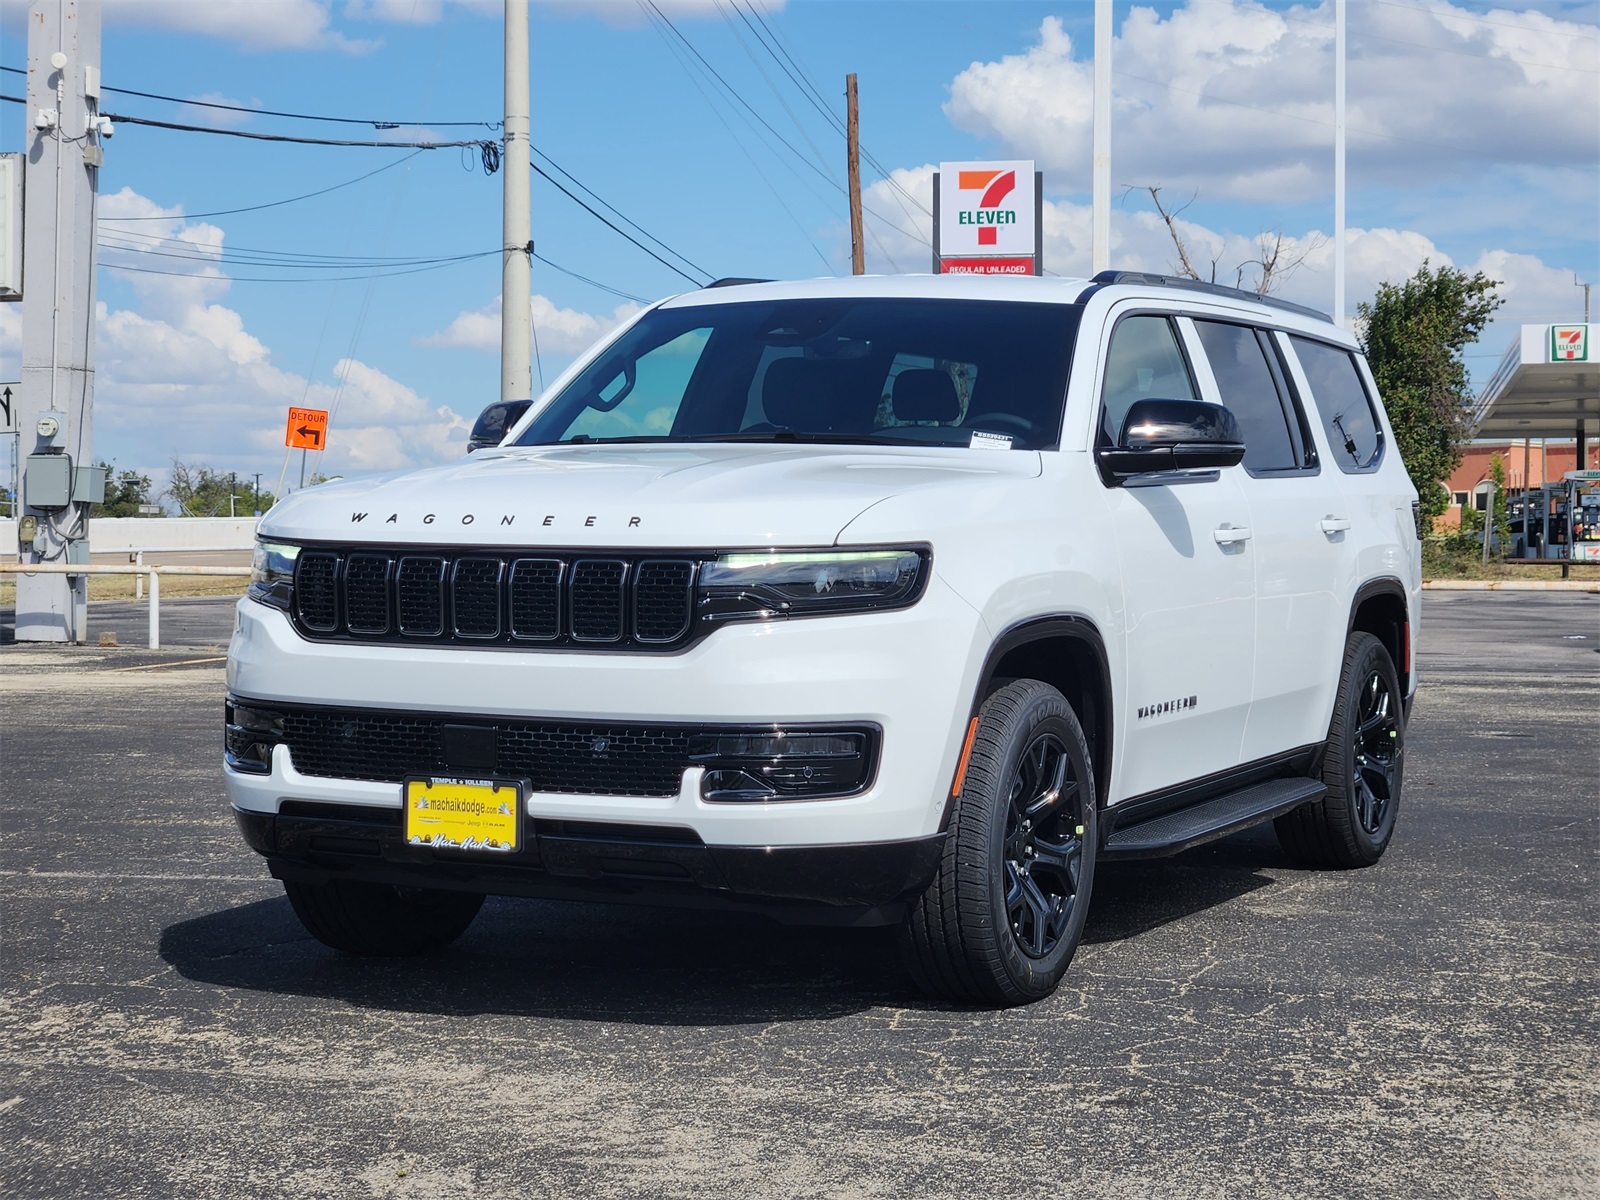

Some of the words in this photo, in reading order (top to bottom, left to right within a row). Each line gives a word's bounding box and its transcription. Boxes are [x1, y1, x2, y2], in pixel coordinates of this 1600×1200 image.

[949, 266, 984, 274] REGULAR
[986, 266, 1026, 274] UNLEADED
[291, 412, 325, 423] DETOUR
[351, 512, 642, 528] WAGONEER
[1137, 697, 1189, 719] WAGONEER
[430, 777, 457, 785] TEMPLE
[465, 779, 493, 787] KILLEEN
[430, 797, 497, 816] machaikdodge.com
[431, 833, 459, 849] Mac
[460, 836, 492, 851] Haik
